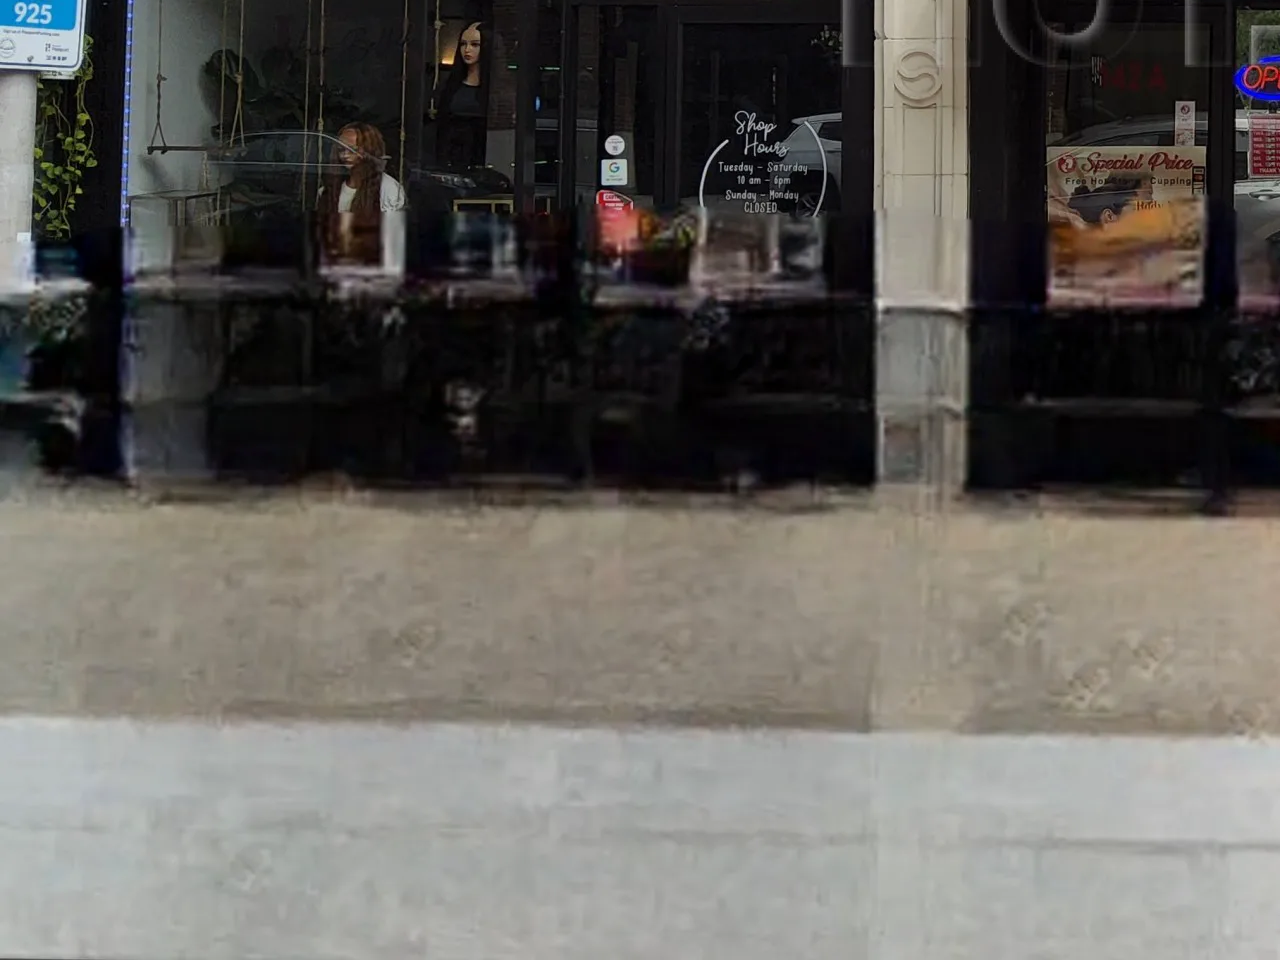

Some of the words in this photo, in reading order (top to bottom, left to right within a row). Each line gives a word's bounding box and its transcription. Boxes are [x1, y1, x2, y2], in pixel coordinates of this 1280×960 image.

[14, 2, 52, 24] 925
[734, 110, 778, 141] Shop
[744, 132, 791, 157] Hours
[718, 161, 754, 175] Tuesday
[767, 161, 808, 175] Saturday
[1081, 151, 1144, 174] Special
[1148, 151, 1194, 171] Price
[737, 175, 745, 184] 10
[749, 176, 761, 184] am
[774, 175, 791, 188] 6pm
[1065, 177, 1087, 185] Free
[1150, 176, 1192, 187] Cupping
[725, 189, 757, 203] Sunday
[769, 189, 799, 203] Monday
[744, 201, 777, 213] CLOSED
